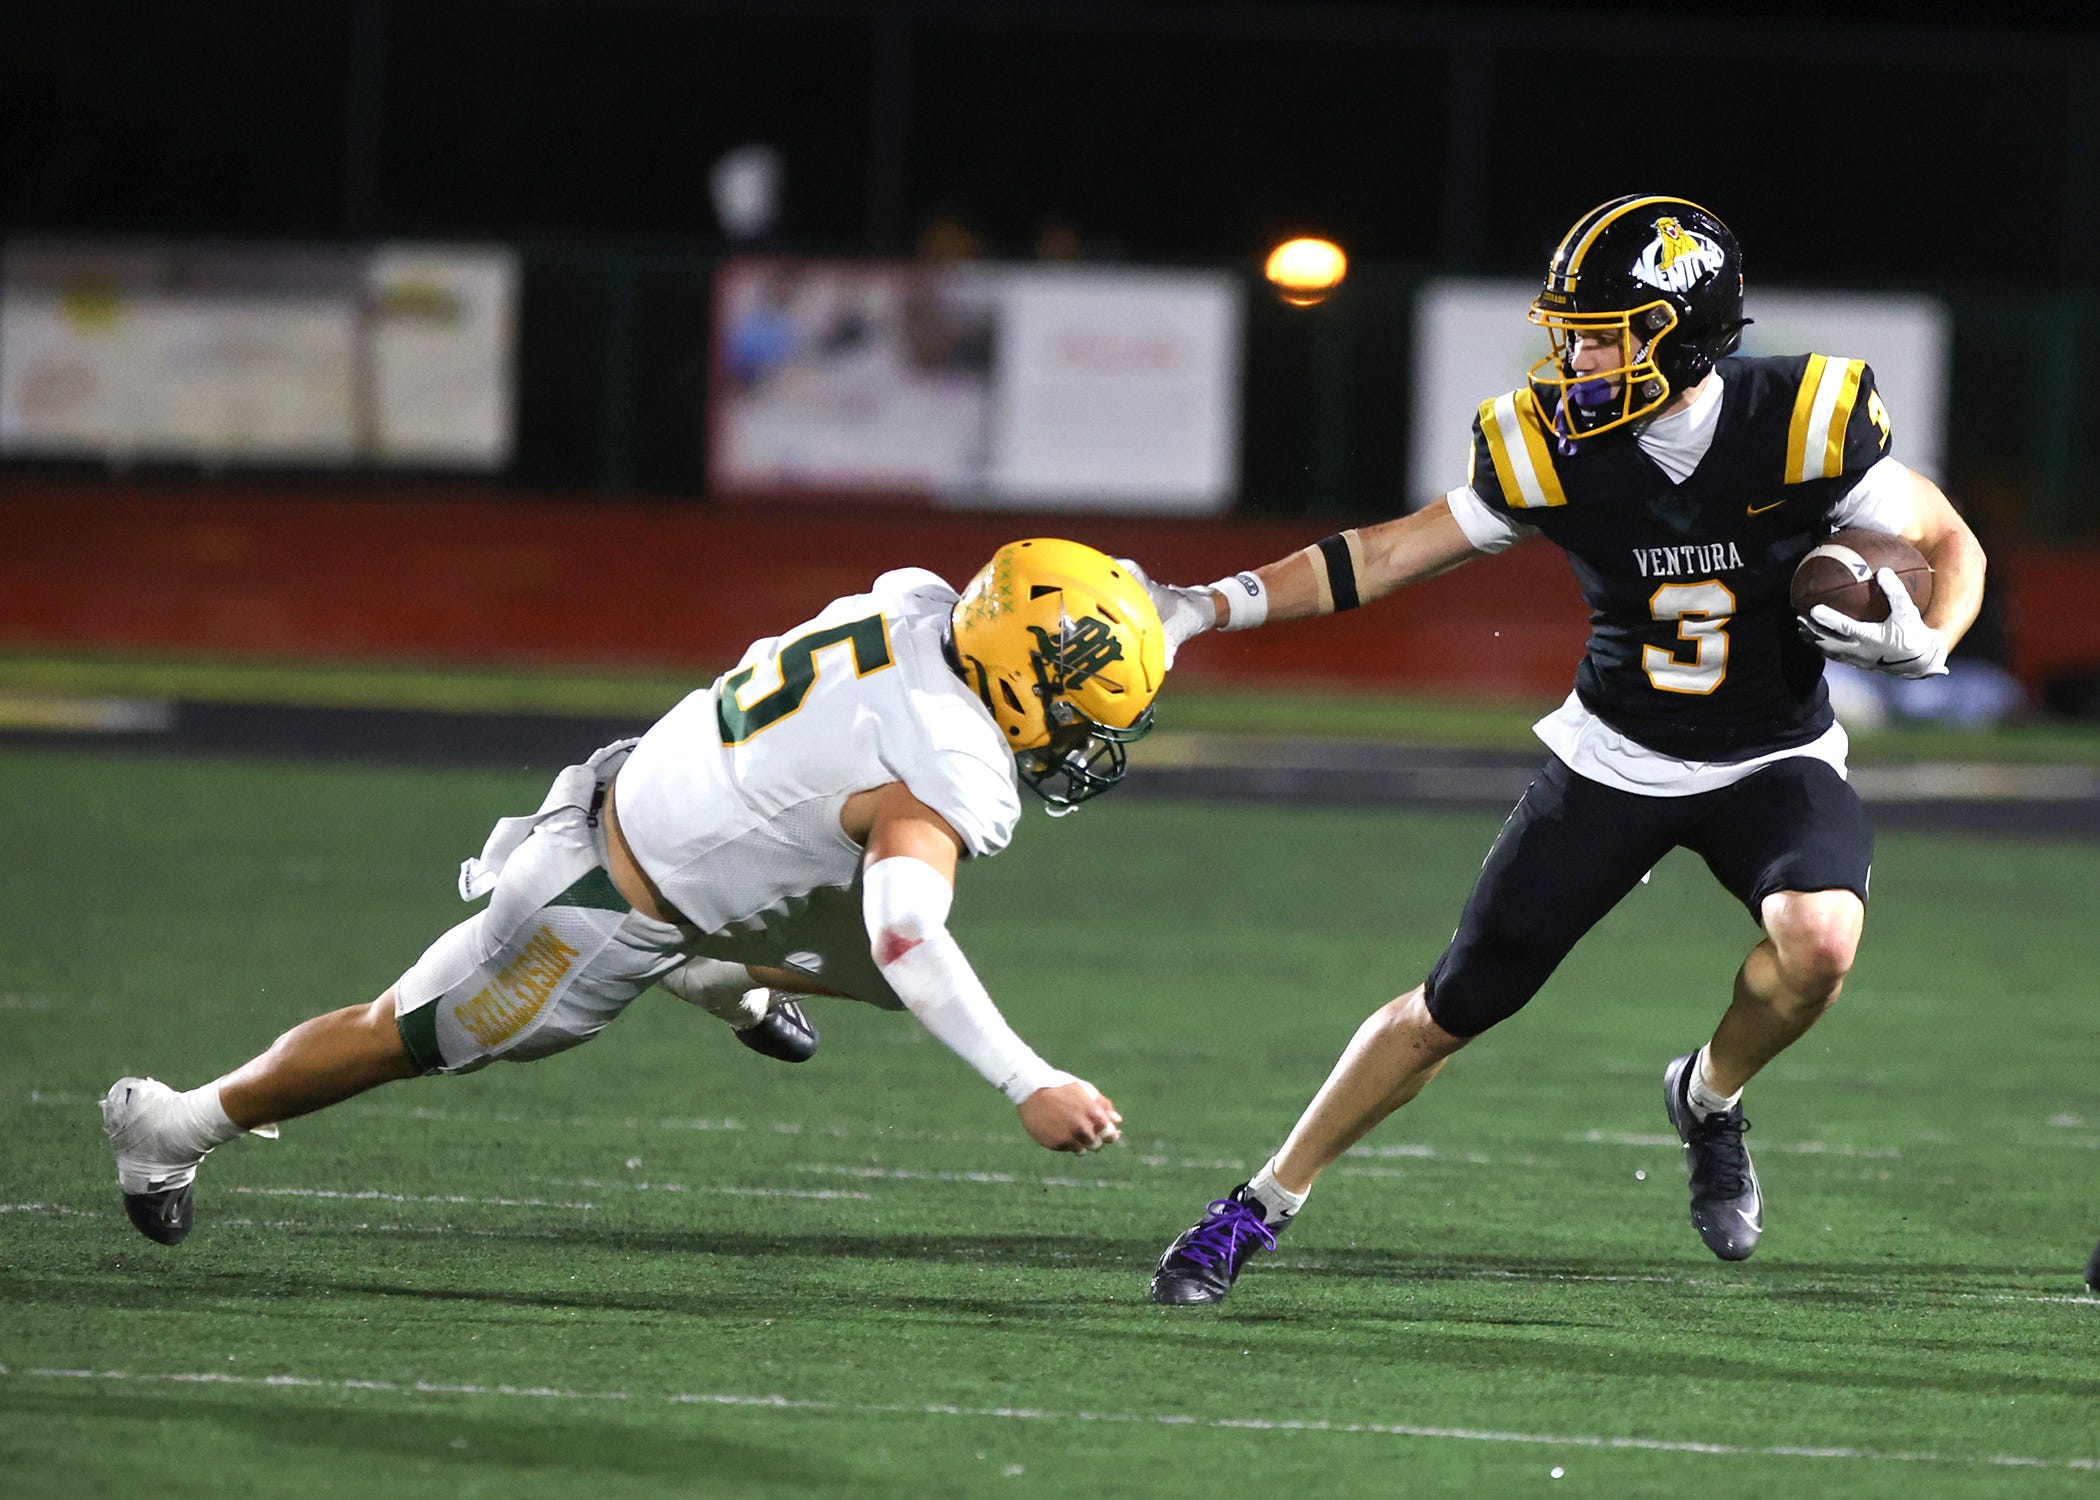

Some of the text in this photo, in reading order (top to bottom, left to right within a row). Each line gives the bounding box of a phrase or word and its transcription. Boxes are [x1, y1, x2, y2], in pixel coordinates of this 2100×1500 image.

[1632, 541, 1744, 577] VENTURA
[717, 611, 896, 748] 5
[1641, 578, 1736, 695] 3
[453, 924, 581, 1048] MUSKETEERS
